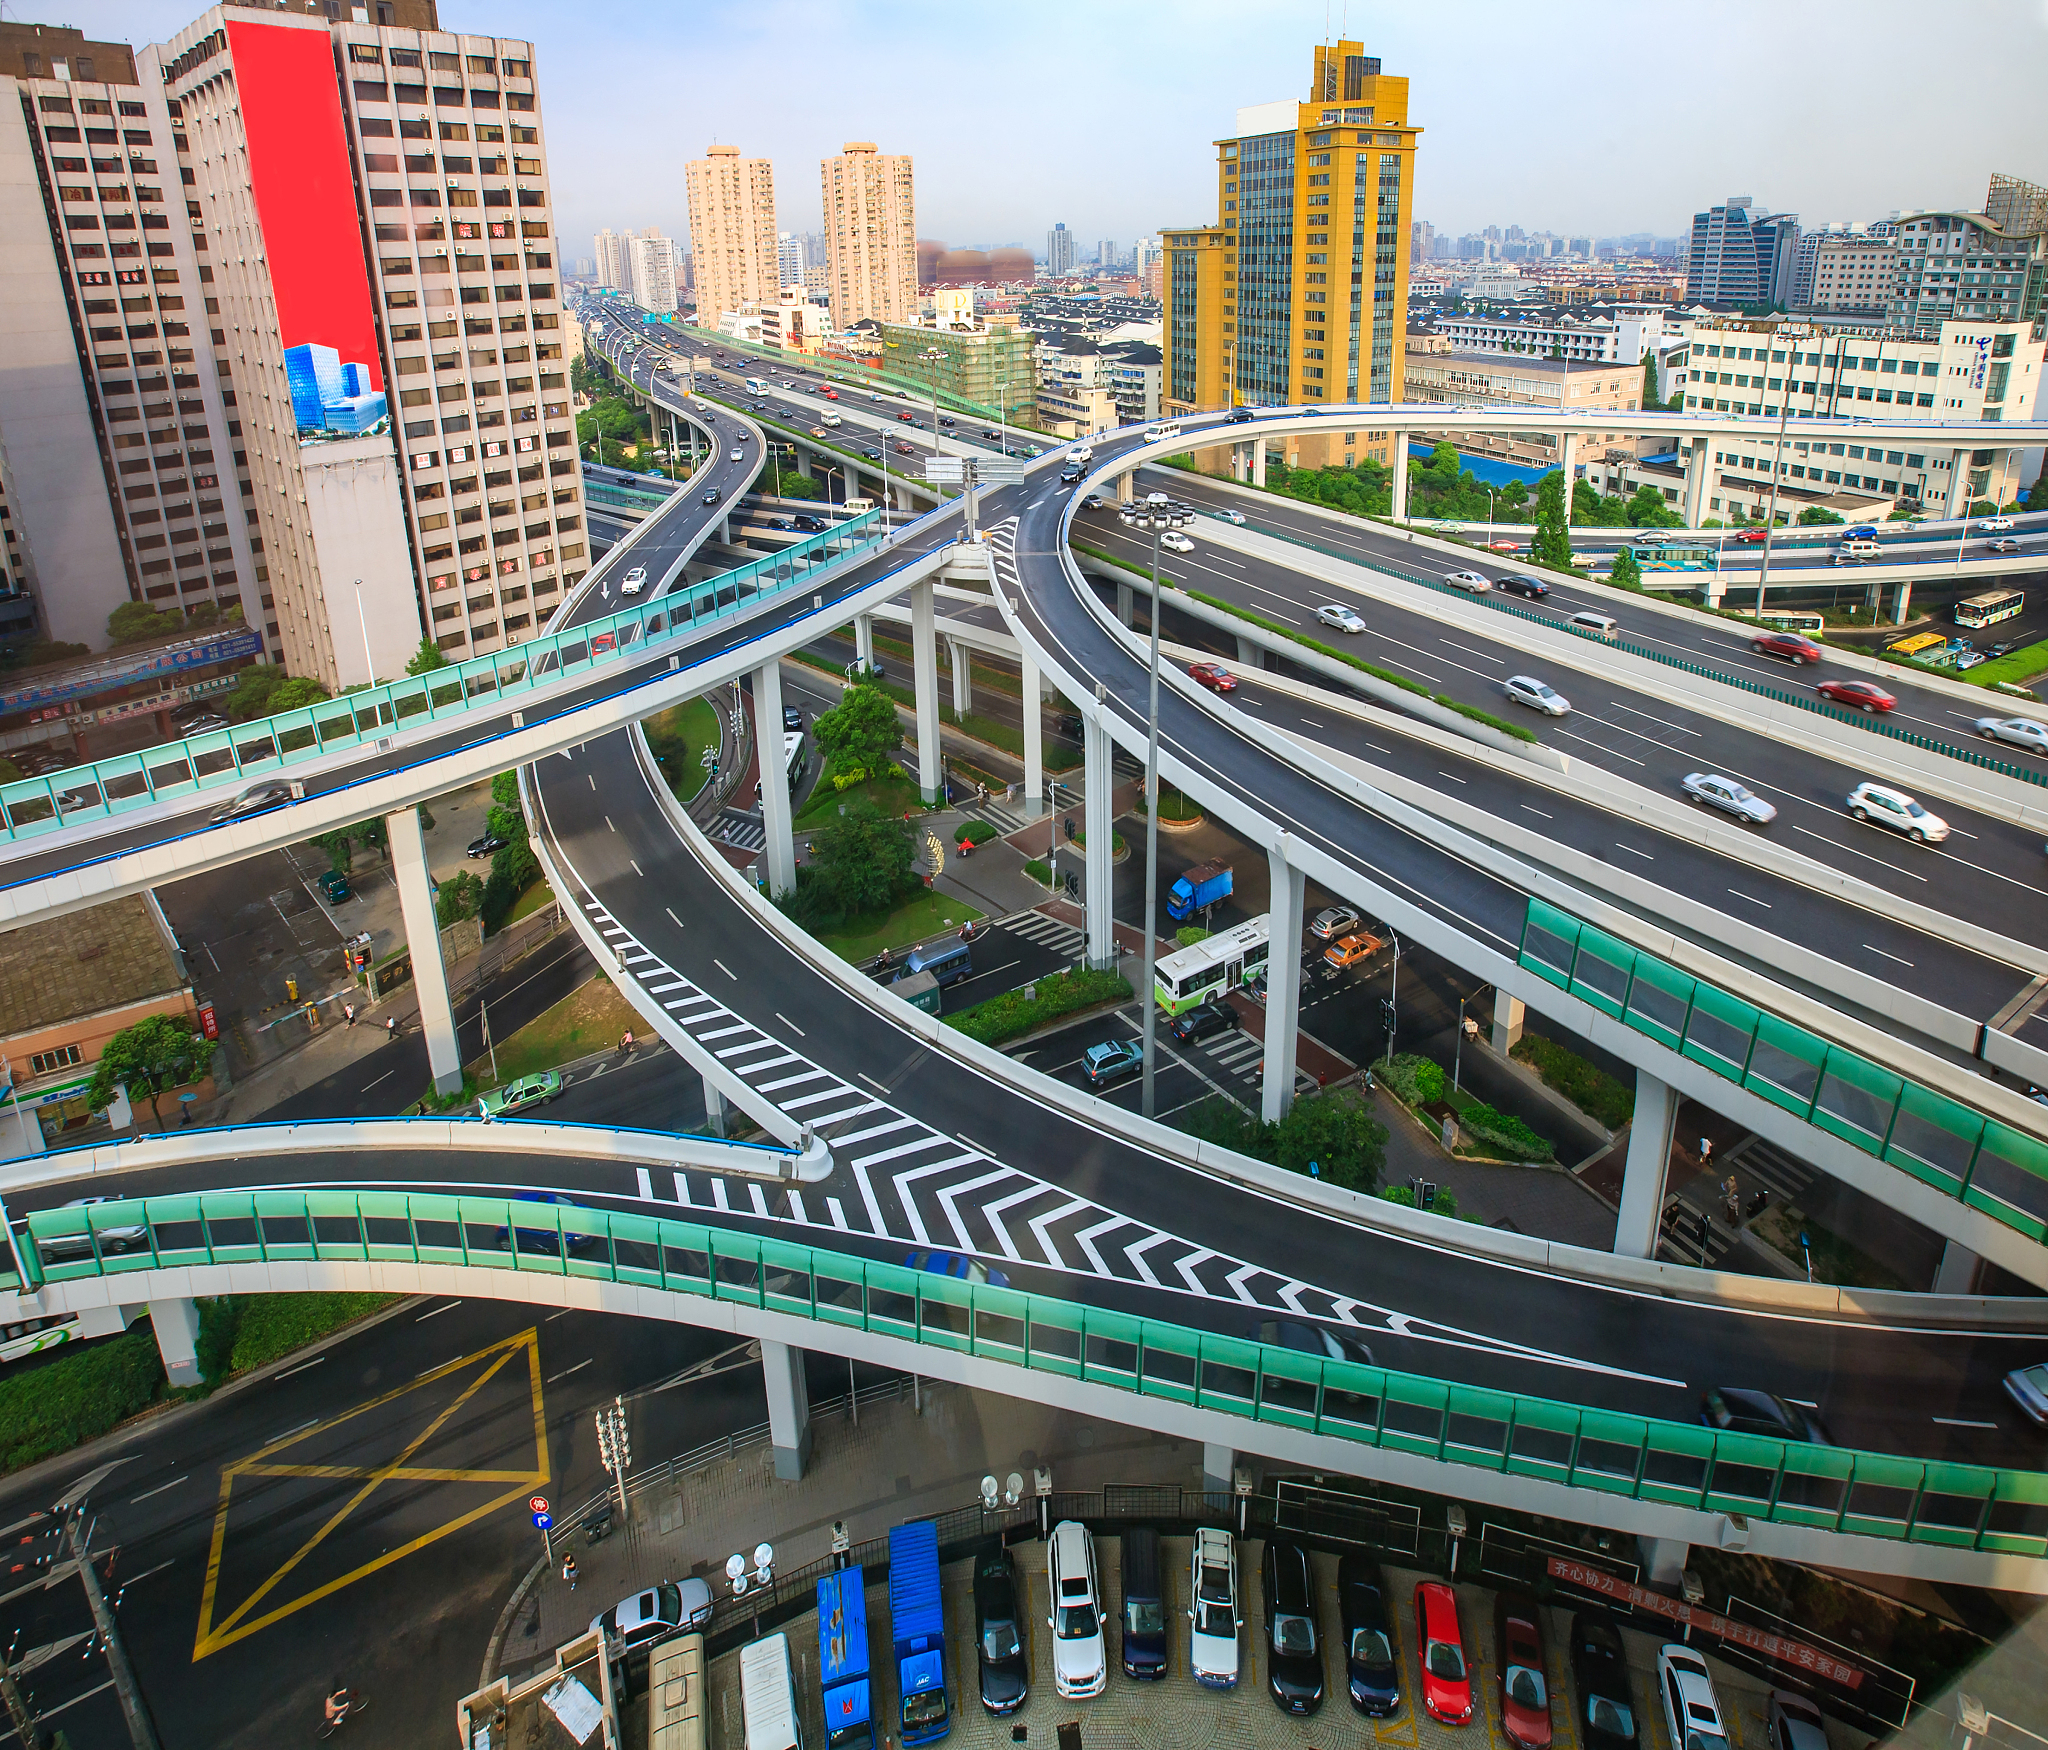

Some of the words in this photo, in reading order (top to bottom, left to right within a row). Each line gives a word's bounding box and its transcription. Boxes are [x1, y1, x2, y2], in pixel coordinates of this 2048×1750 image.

[533, 1499, 546, 1510] 停
[1711, 1615, 1851, 1684] 携手打造平安家园
[916, 1676, 929, 1687] JAC
